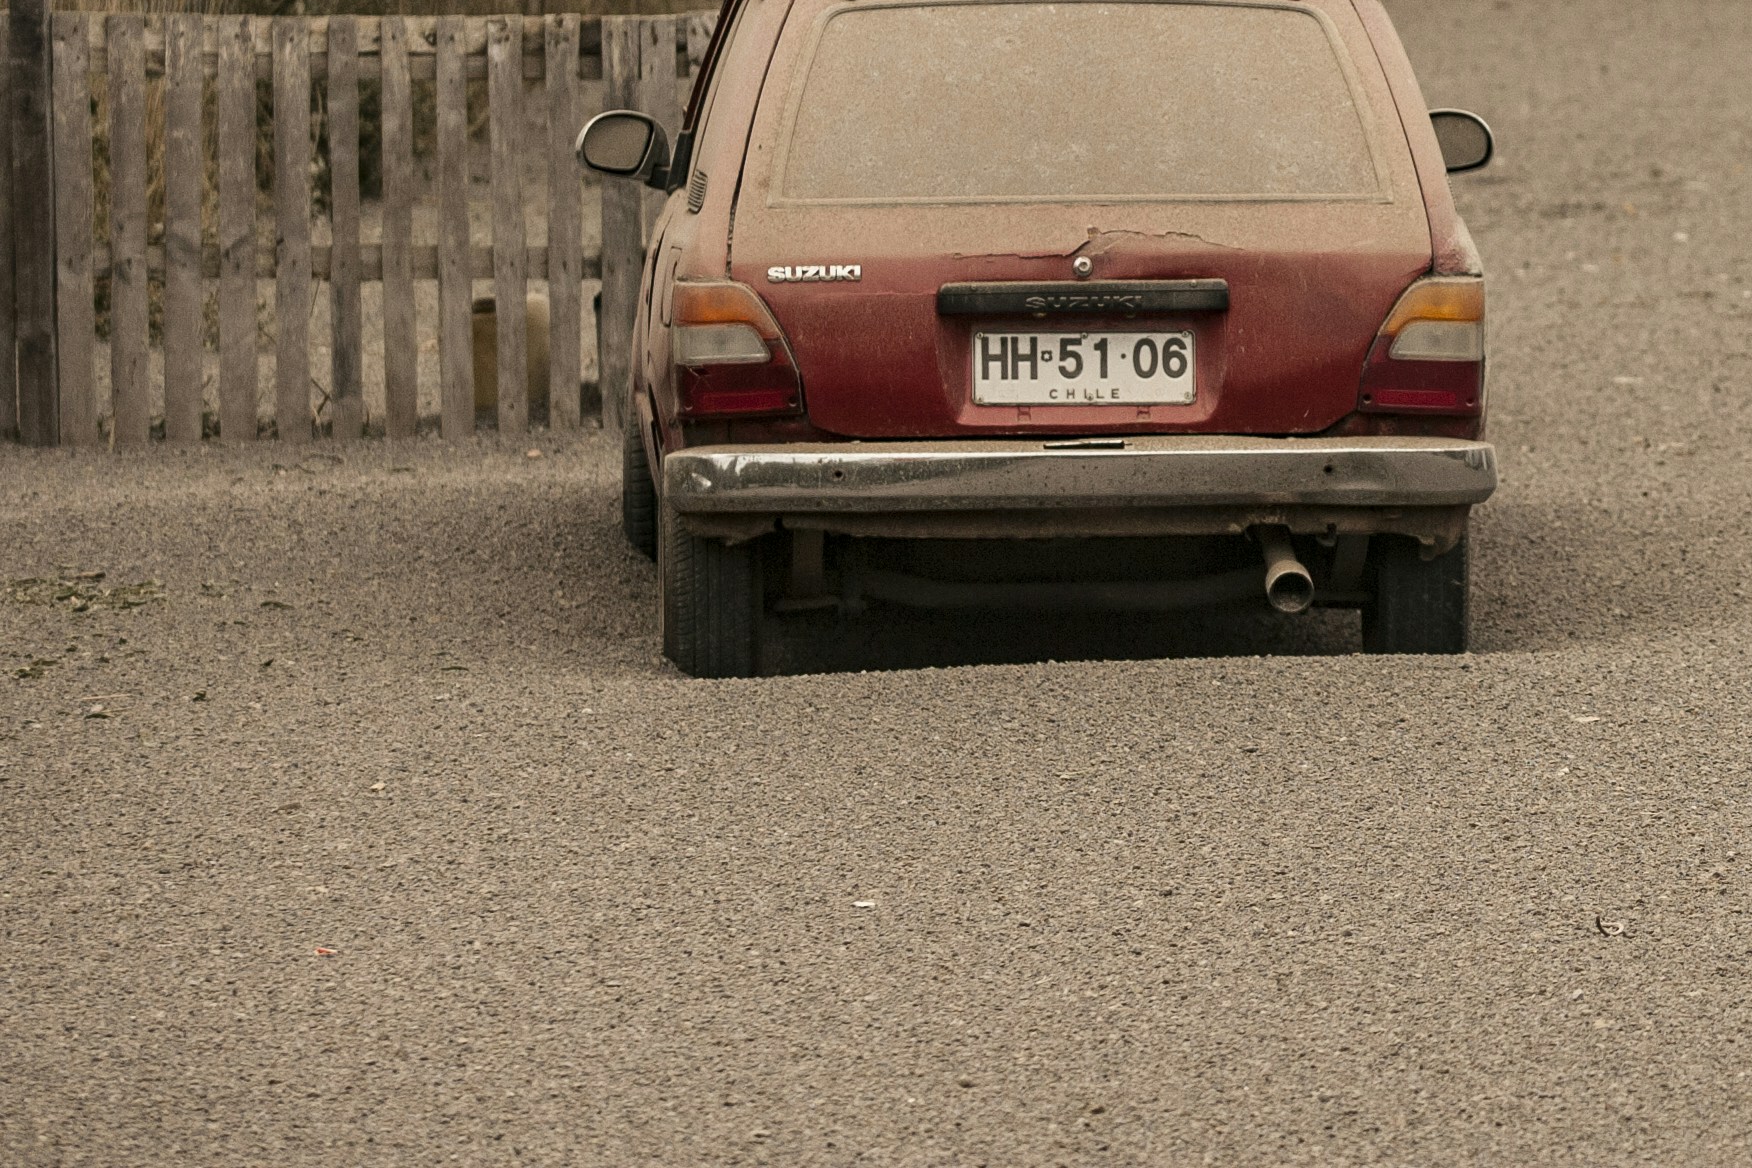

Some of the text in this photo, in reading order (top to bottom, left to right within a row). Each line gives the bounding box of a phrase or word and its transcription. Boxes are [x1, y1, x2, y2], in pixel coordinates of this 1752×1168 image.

[767, 264, 862, 283] SUZUKI
[1025, 295, 1142, 310] SUZUKI
[1049, 388, 1120, 400] CHILE
